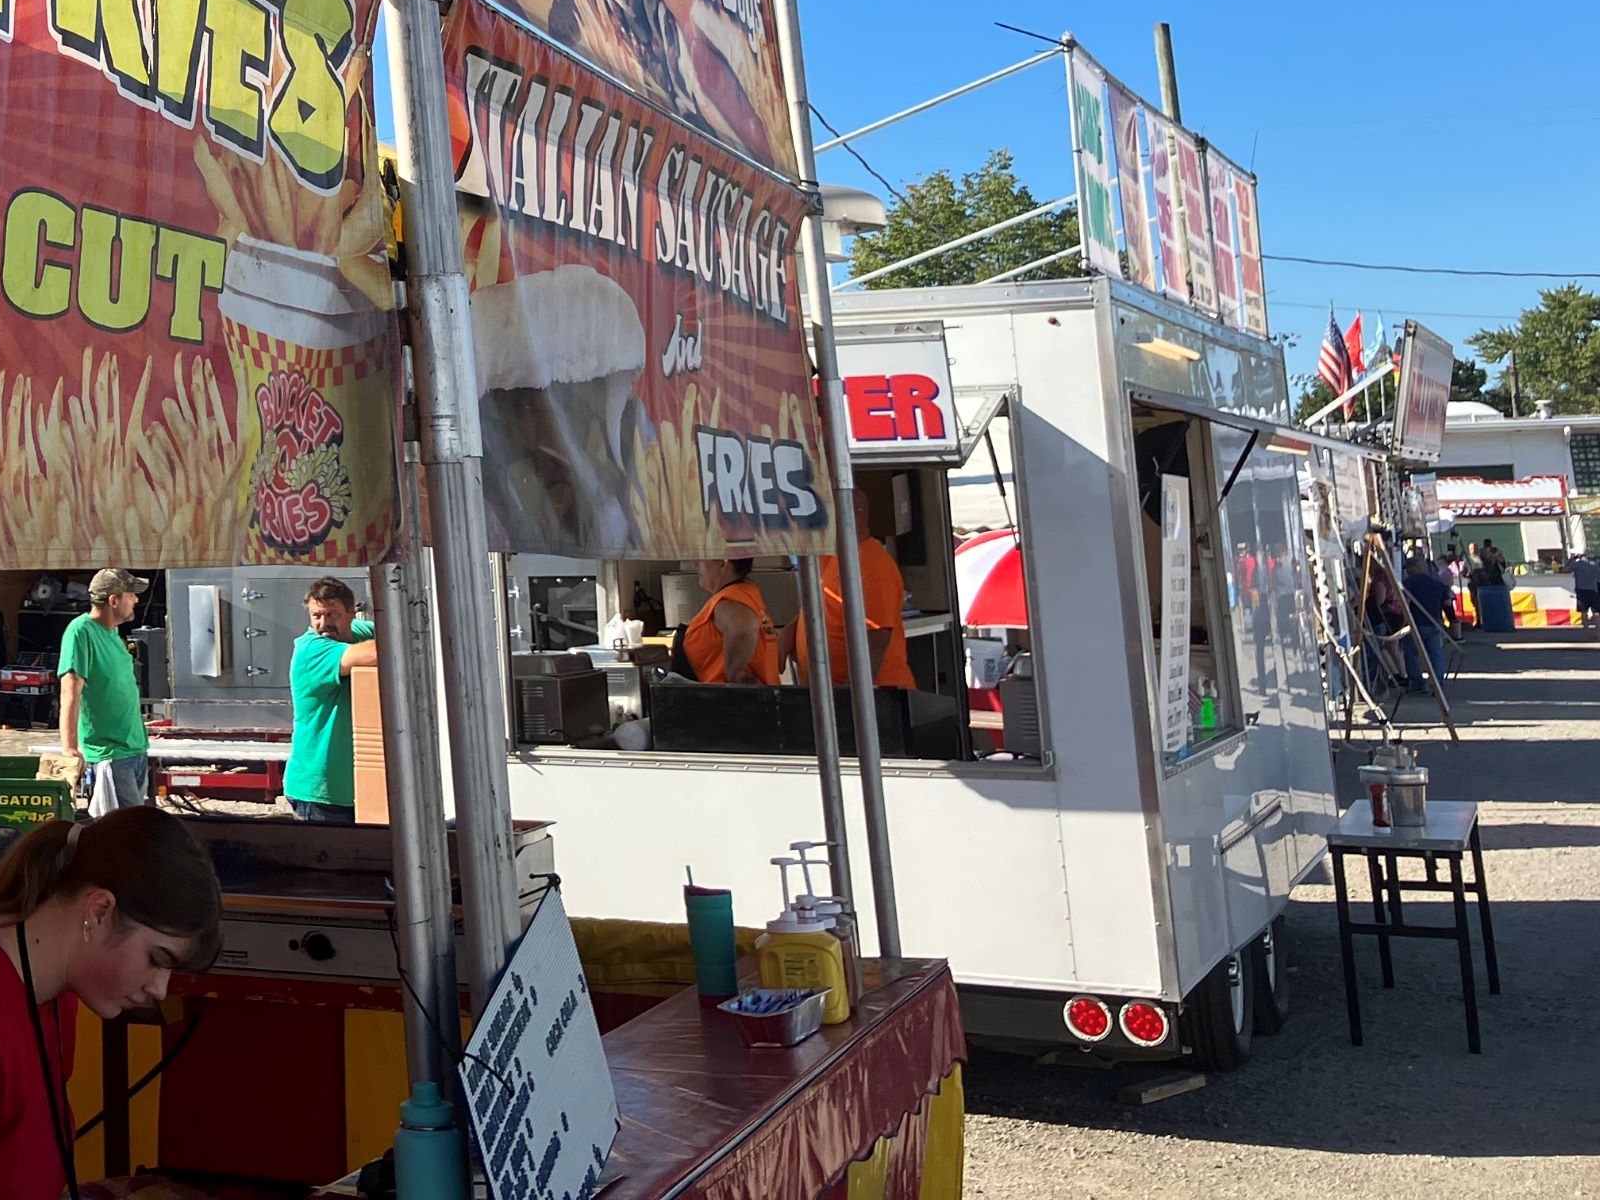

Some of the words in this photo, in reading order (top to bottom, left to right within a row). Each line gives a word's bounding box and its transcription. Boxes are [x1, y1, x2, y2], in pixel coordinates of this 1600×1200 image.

[455, 50, 654, 251] ITALIAN
[655, 145, 789, 324] SAUSAGE
[1, 186, 228, 346] CUT
[254, 371, 345, 452] BUCKET
[842, 373, 947, 442] ER
[1450, 506, 1495, 517] ORN
[1501, 505, 1564, 516] DOGS
[27, 811, 55, 824] 4x2
